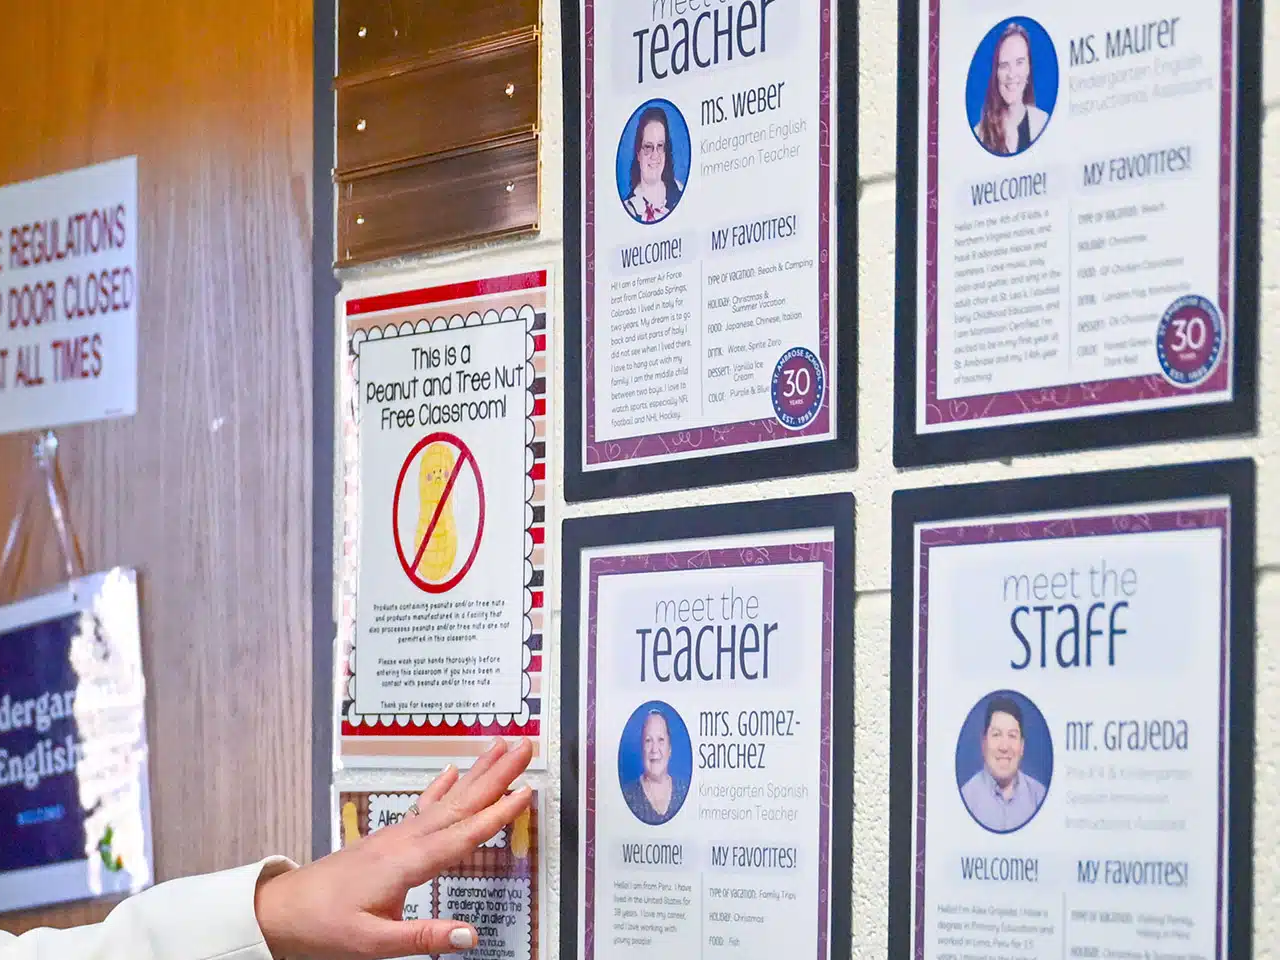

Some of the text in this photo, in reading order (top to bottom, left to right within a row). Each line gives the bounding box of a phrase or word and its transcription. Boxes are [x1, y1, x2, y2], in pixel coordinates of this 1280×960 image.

[1070, 35, 1099, 67] MS.
[700, 118, 807, 155] Kindergarten English
[700, 144, 800, 176] Immersion Teacher
[10, 203, 125, 268] REGULATIONS
[758, 265, 777, 275] Beach
[778, 263, 783, 271] &
[785, 260, 813, 270] Camping
[9, 280, 56, 329] DOOR
[64, 267, 133, 320] CLOSED
[1171, 317, 1206, 352] 30
[15, 345, 44, 387] ALL
[51, 334, 103, 383] TIMES
[412, 345, 470, 370] This is a
[777, 349, 804, 371] AMBROSE
[805, 351, 822, 381] SCHOOL
[367, 364, 523, 403] Peanut and Tree Nut
[783, 368, 810, 397] 30
[381, 395, 506, 430] Free Classroom!
[782, 413, 794, 424] EST.
[1003, 560, 1138, 602] meet the
[655, 586, 759, 624] meet the
[399, 702, 408, 711] you
[410, 700, 419, 708] for
[421, 702, 442, 710] keeping
[699, 782, 808, 802] Kindergarten Spanish
[699, 806, 798, 821] Immersion Teacher
[447, 887, 522, 900] Understand what you
